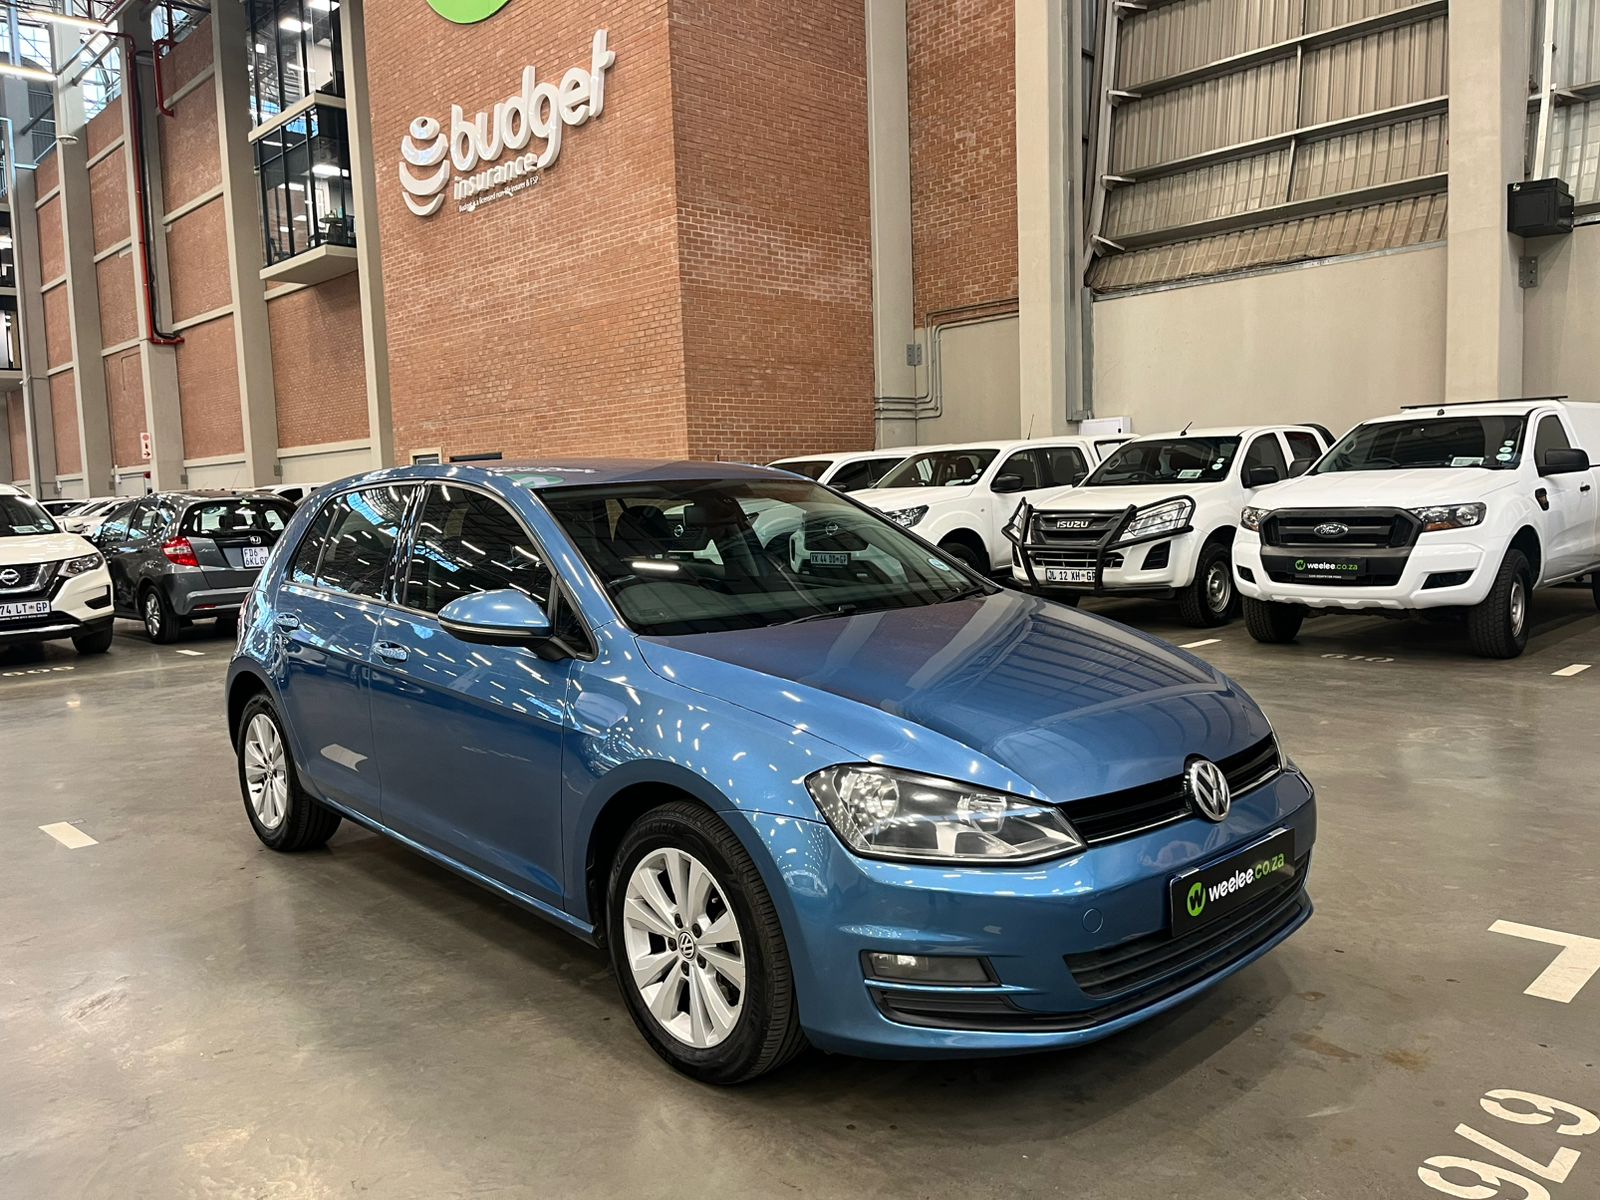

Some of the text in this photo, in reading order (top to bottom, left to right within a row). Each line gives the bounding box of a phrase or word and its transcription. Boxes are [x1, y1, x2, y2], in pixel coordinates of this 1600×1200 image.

[451, 28, 616, 171] budget
[454, 152, 538, 200] insurance
[1056, 521, 1089, 529] ISUZU
[1307, 561, 1358, 571] weelee.co.za
[1059, 571, 1068, 580] 12
[15, 603, 28, 614] LT
[35, 602, 48, 612] GP
[1208, 852, 1286, 902] weelee.co.za
